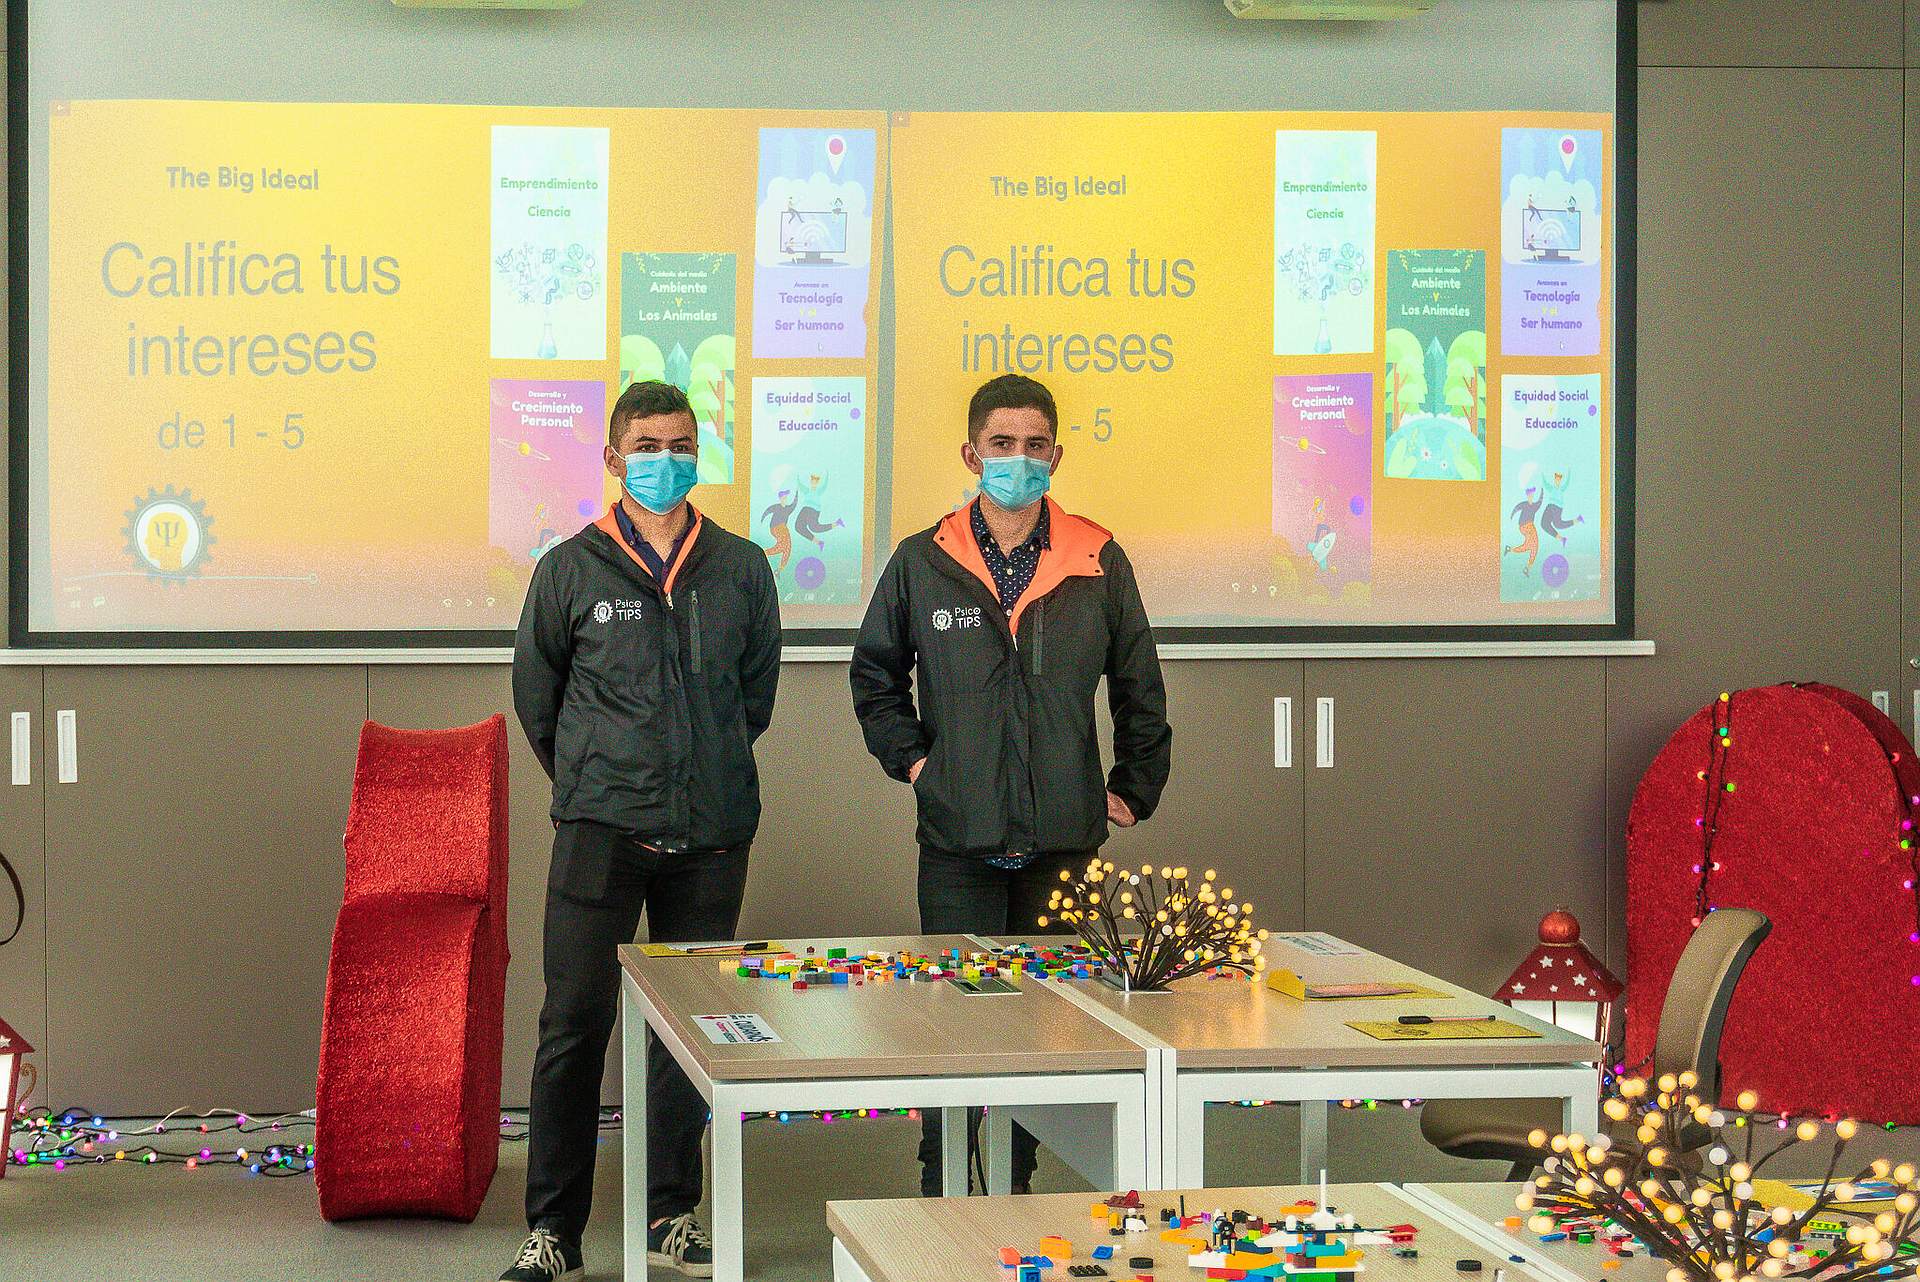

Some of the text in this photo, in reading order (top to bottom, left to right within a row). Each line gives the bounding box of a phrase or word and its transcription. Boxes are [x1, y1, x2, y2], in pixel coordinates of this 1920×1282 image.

[166, 166, 319, 194] The Big Ideal
[500, 177, 598, 192] Emprendimiento
[990, 175, 1127, 201] The Big Ideal
[1283, 181, 1368, 195] Emprendimiento
[527, 205, 571, 217] Ciencia
[1306, 208, 1344, 219] Ciencia
[101, 239, 401, 298] Califica tus
[939, 244, 1196, 298] Califica tus
[650, 281, 708, 294] Ambiente
[1411, 277, 1461, 289] Ambiente
[778, 292, 843, 307] Tecnología
[1523, 289, 1581, 305] Tecnología
[639, 308, 718, 322] Los Animales
[1401, 303, 1471, 317] Los Animales
[775, 319, 844, 331] Ser humano
[1521, 317, 1583, 330] Ser humano
[128, 322, 378, 378] intereses
[962, 320, 1174, 373] intereses
[767, 391, 851, 407] Equidad Social
[1291, 395, 1354, 408] Crecimiento
[1514, 389, 1589, 405] Equidad Social
[511, 401, 584, 414] Crecimiento
[1300, 408, 1346, 421] Personal
[521, 414, 574, 428] Personal
[779, 419, 838, 431] Educación
[1093, 407, 1113, 443] 5
[1525, 417, 1578, 429] Educación
[157, 411, 206, 450] de
[222, 413, 236, 448] 1
[282, 413, 306, 450] 5
[615, 599, 642, 608] Psico
[616, 609, 642, 621] TIPS
[954, 607, 981, 617] Psico
[955, 616, 981, 629] TIPS
